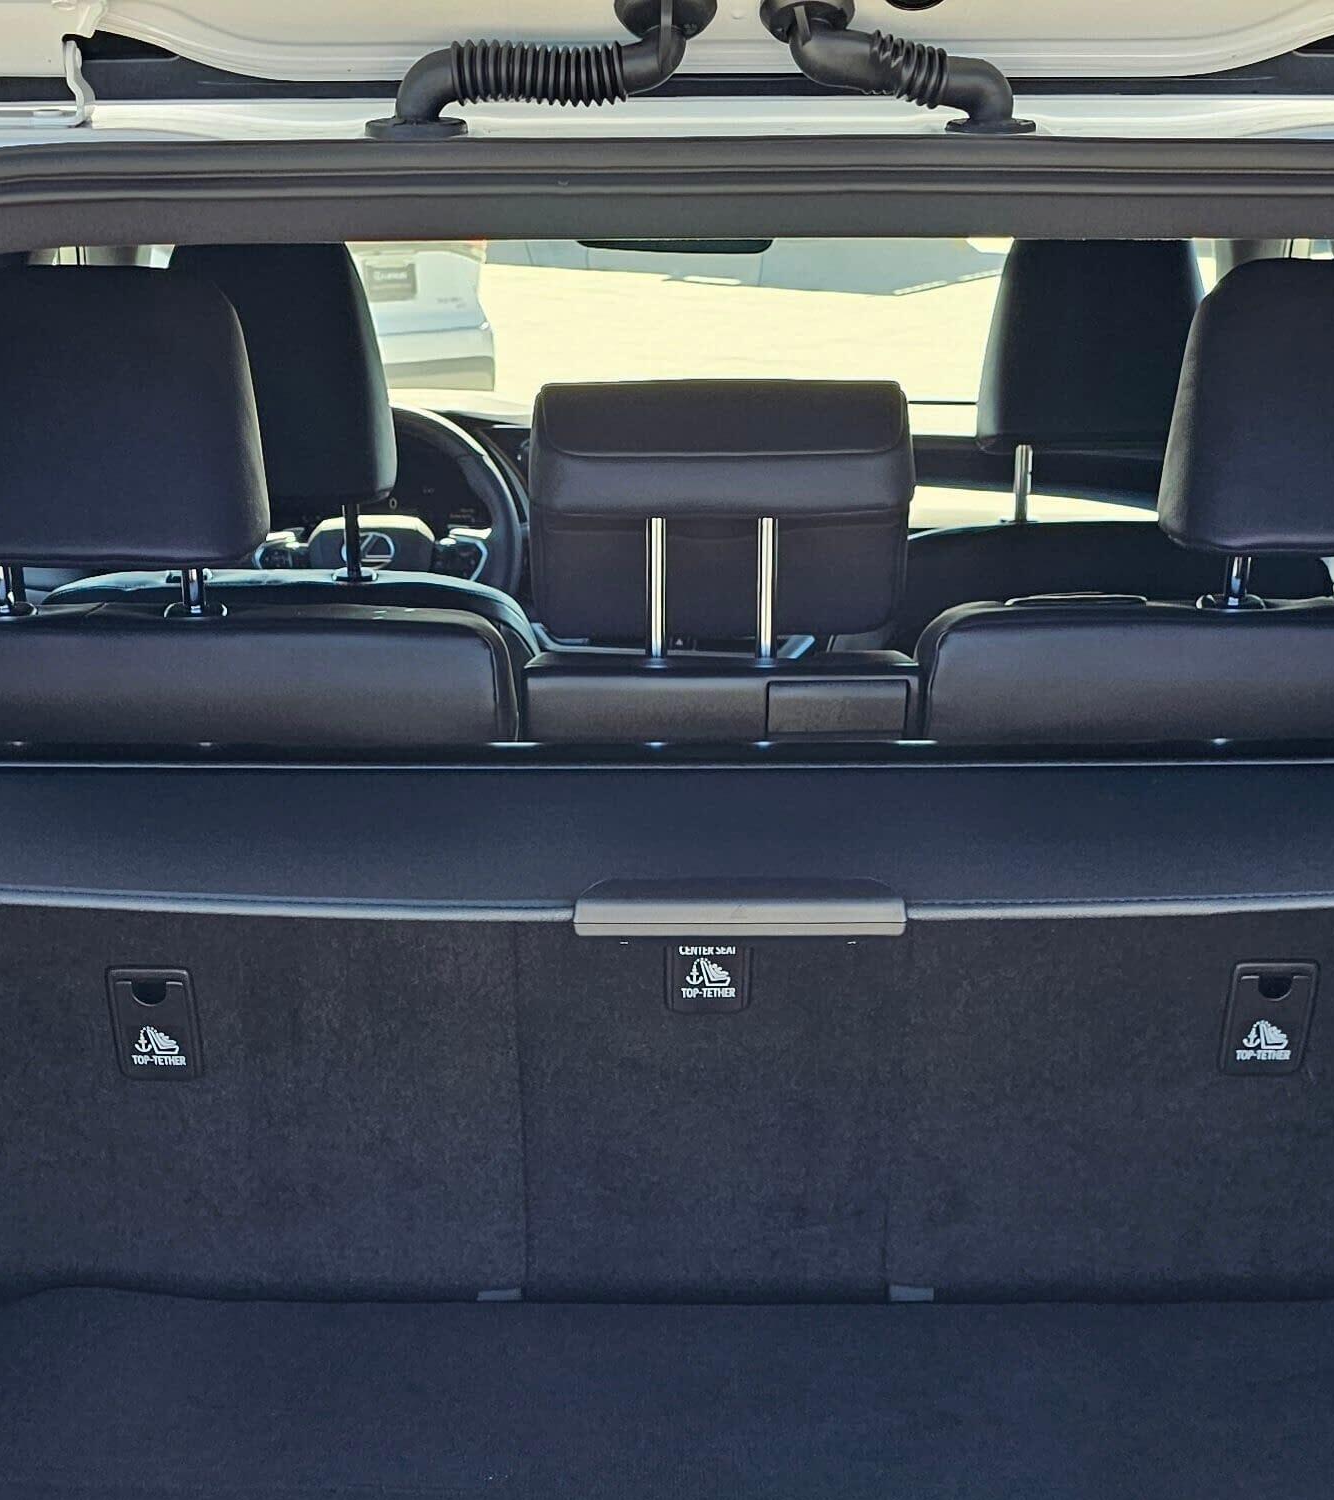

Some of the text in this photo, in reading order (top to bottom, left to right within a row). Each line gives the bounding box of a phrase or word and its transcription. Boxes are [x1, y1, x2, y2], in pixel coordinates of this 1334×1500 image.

[679, 946, 736, 955] CENTER SEAT
[681, 987, 736, 998] TOP-TETHER
[1236, 1049, 1291, 1060] TOP-TETHER
[132, 1055, 187, 1066] TOP-TETHER
